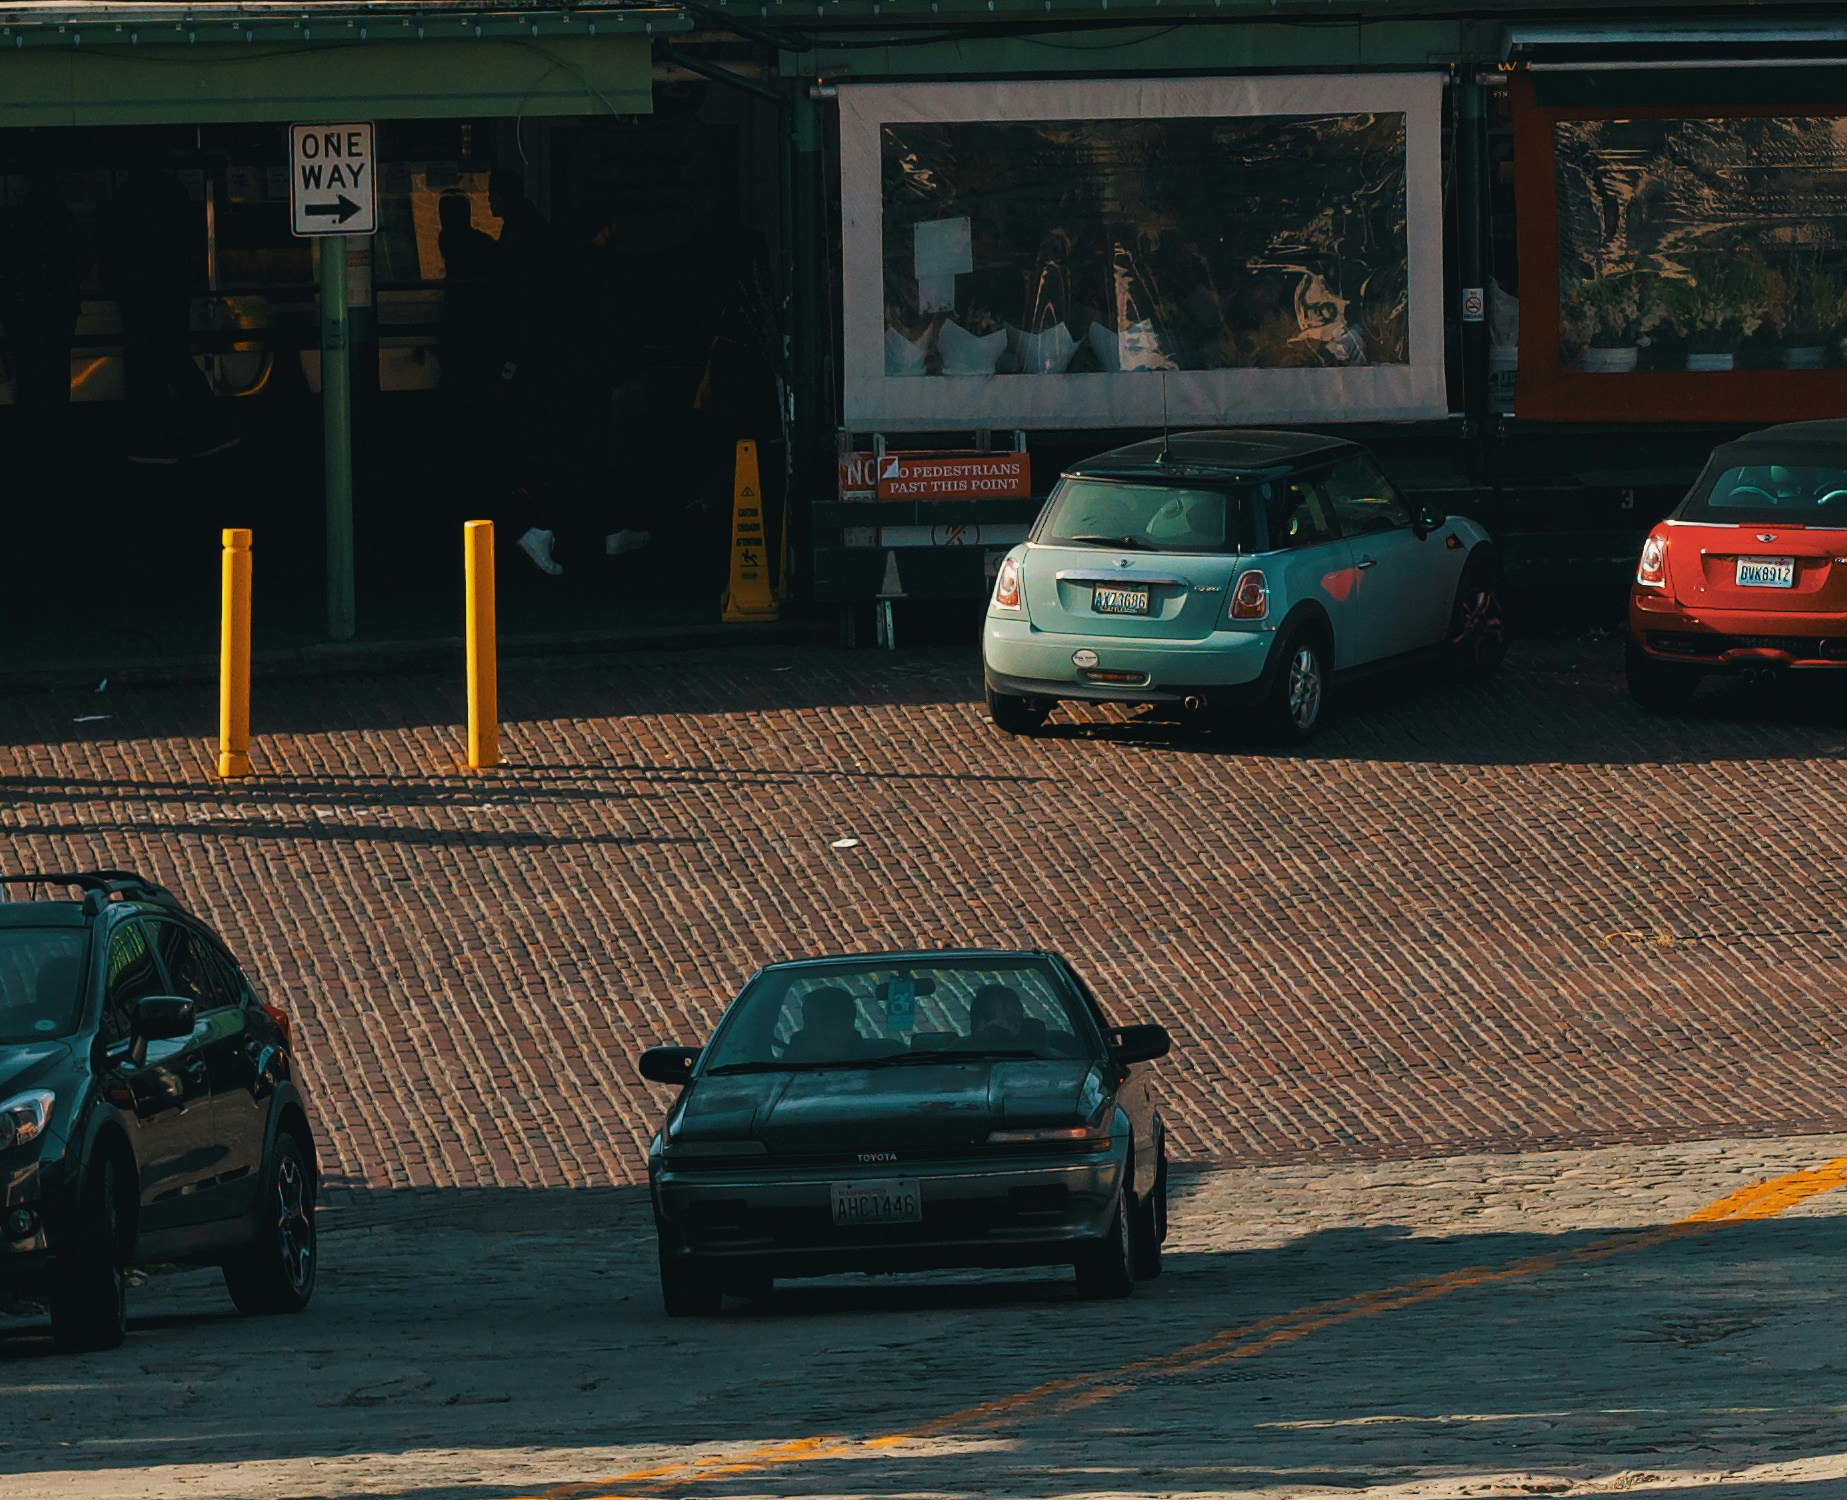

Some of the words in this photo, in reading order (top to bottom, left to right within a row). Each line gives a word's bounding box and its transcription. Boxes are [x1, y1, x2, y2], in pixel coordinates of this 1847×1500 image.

[302, 132, 363, 159] ONE
[301, 163, 365, 190] WAY
[913, 463, 1020, 479] PEDESTRIANS
[889, 481, 927, 494] PAST
[931, 480, 967, 493] THIS
[971, 478, 1019, 491] POINT
[1620, 488, 1634, 509] 3
[856, 1152, 898, 1162] TOYOTA
[838, 1194, 915, 1218] AHC1446
